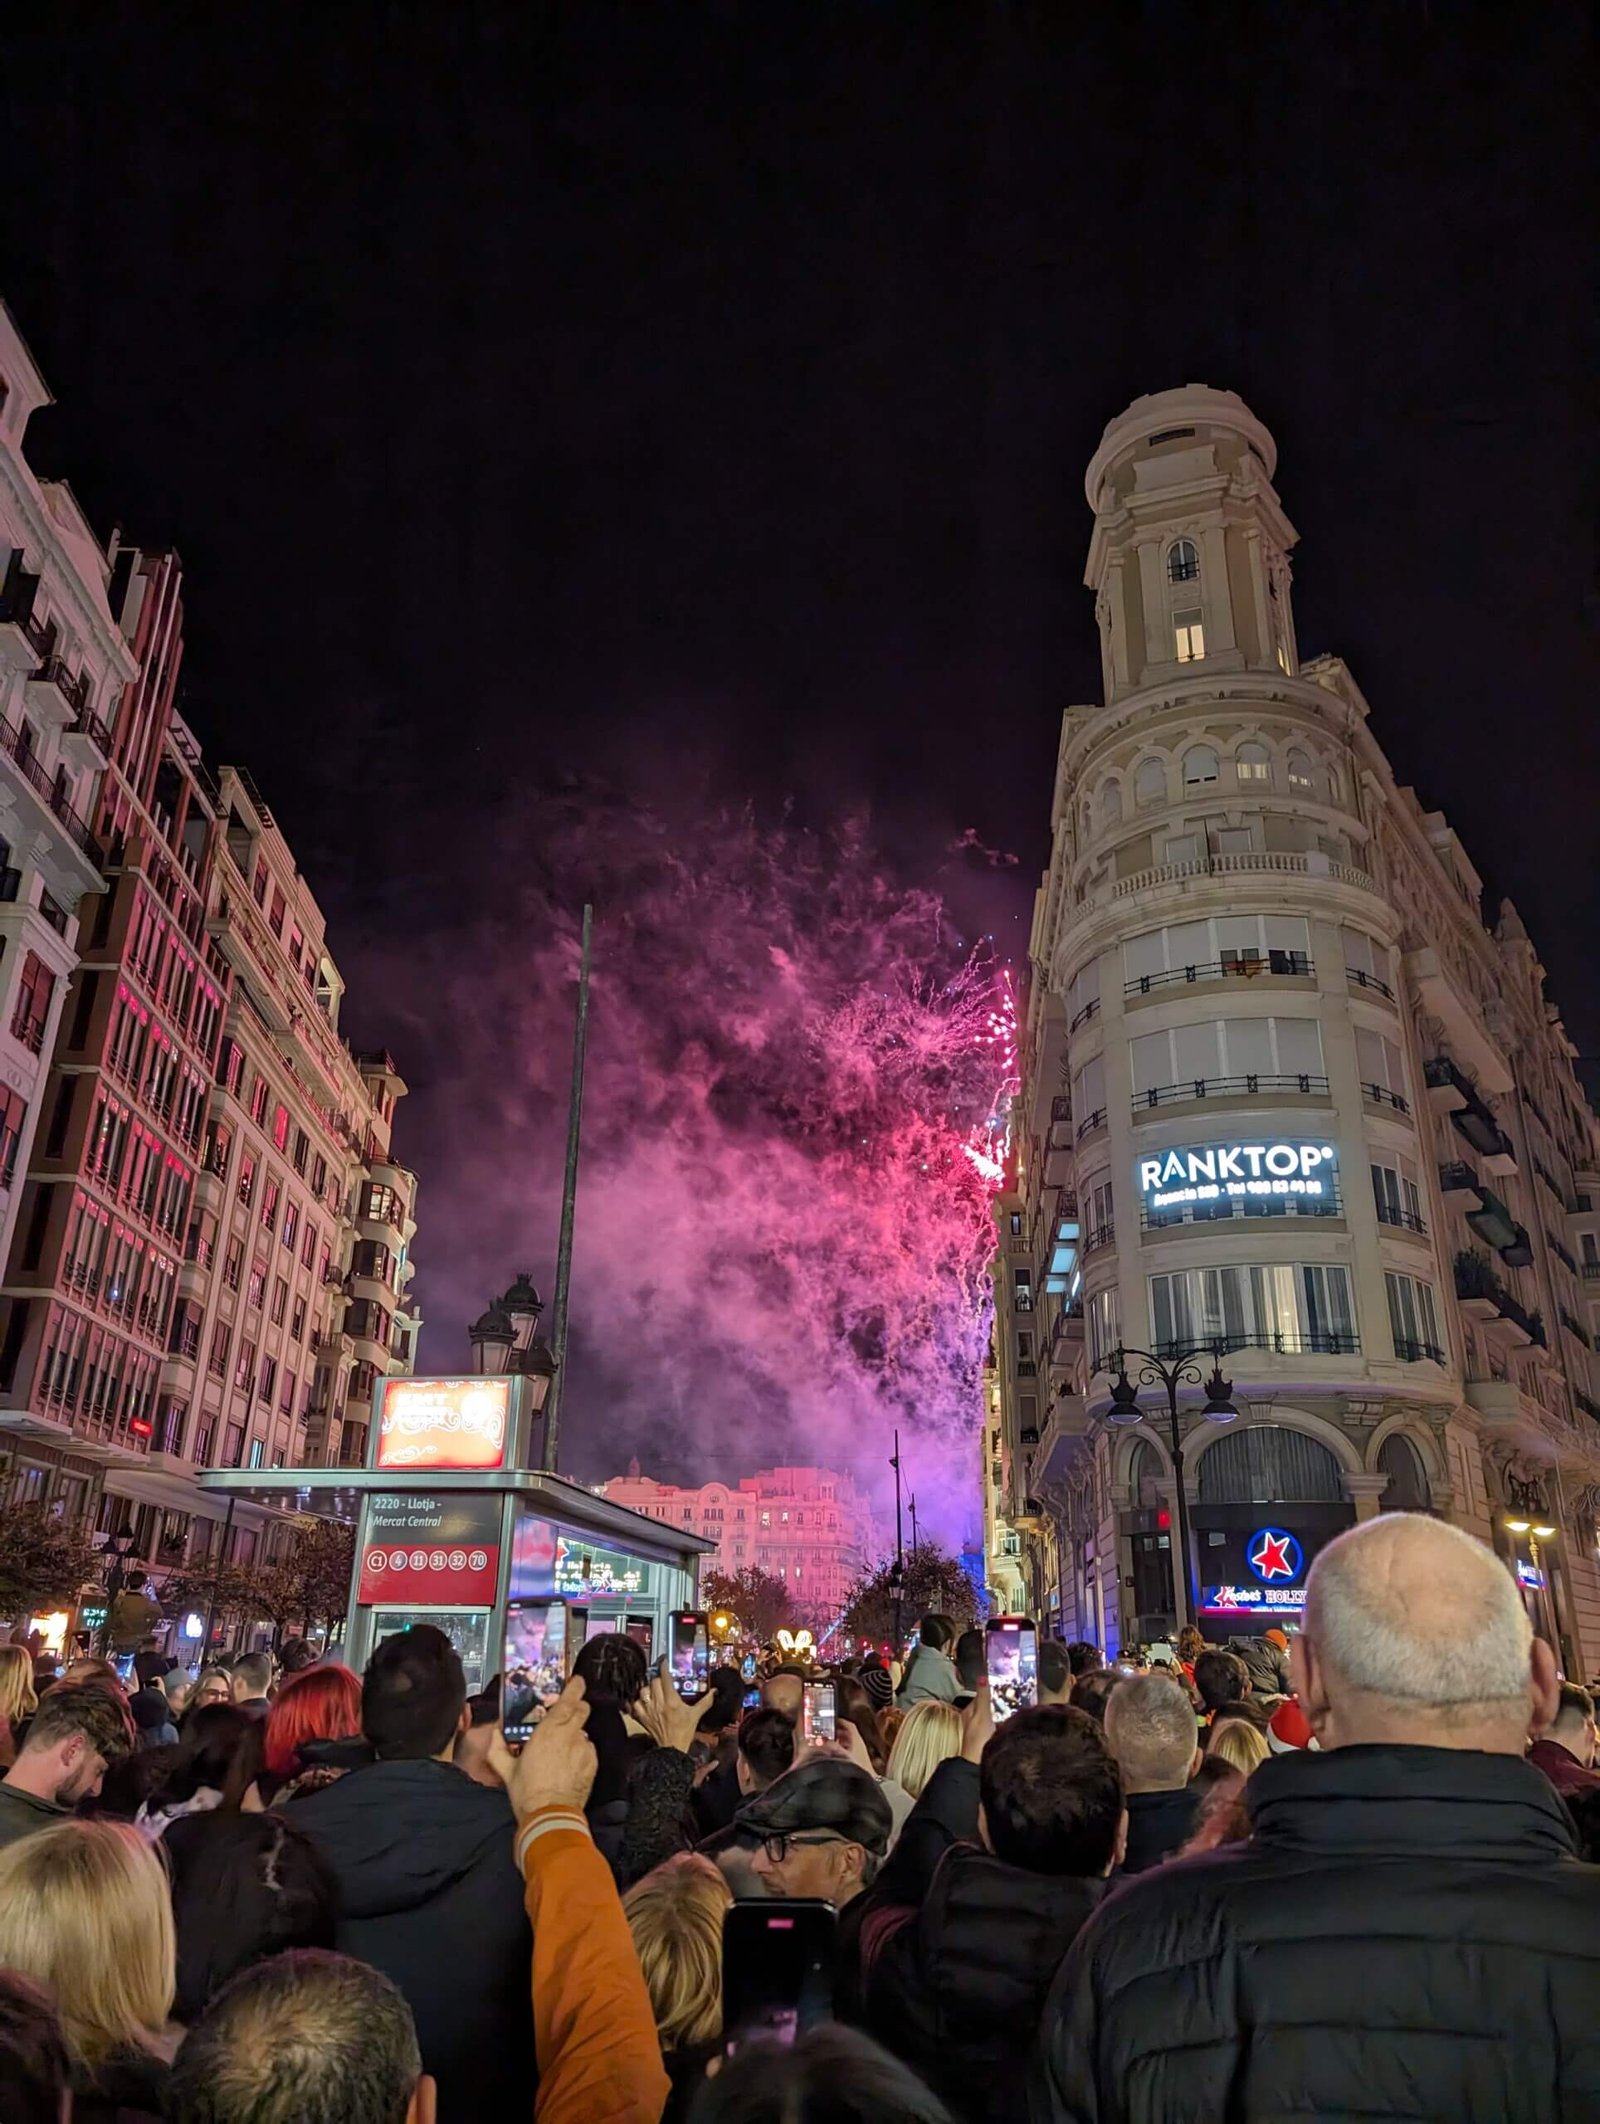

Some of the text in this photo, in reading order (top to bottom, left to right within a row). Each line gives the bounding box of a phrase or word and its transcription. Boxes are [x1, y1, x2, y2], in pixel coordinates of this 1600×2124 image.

[1141, 1145, 1323, 1191] RANKTOP
[374, 1498, 400, 1509] 2220
[408, 1498, 435, 1512] Llotja
[373, 1516, 442, 1527] Mercat Central
[370, 1555, 383, 1567] C1
[413, 1555, 424, 1566] 11
[432, 1555, 444, 1566] 31
[451, 1555, 464, 1566] 32
[472, 1555, 485, 1566] 70
